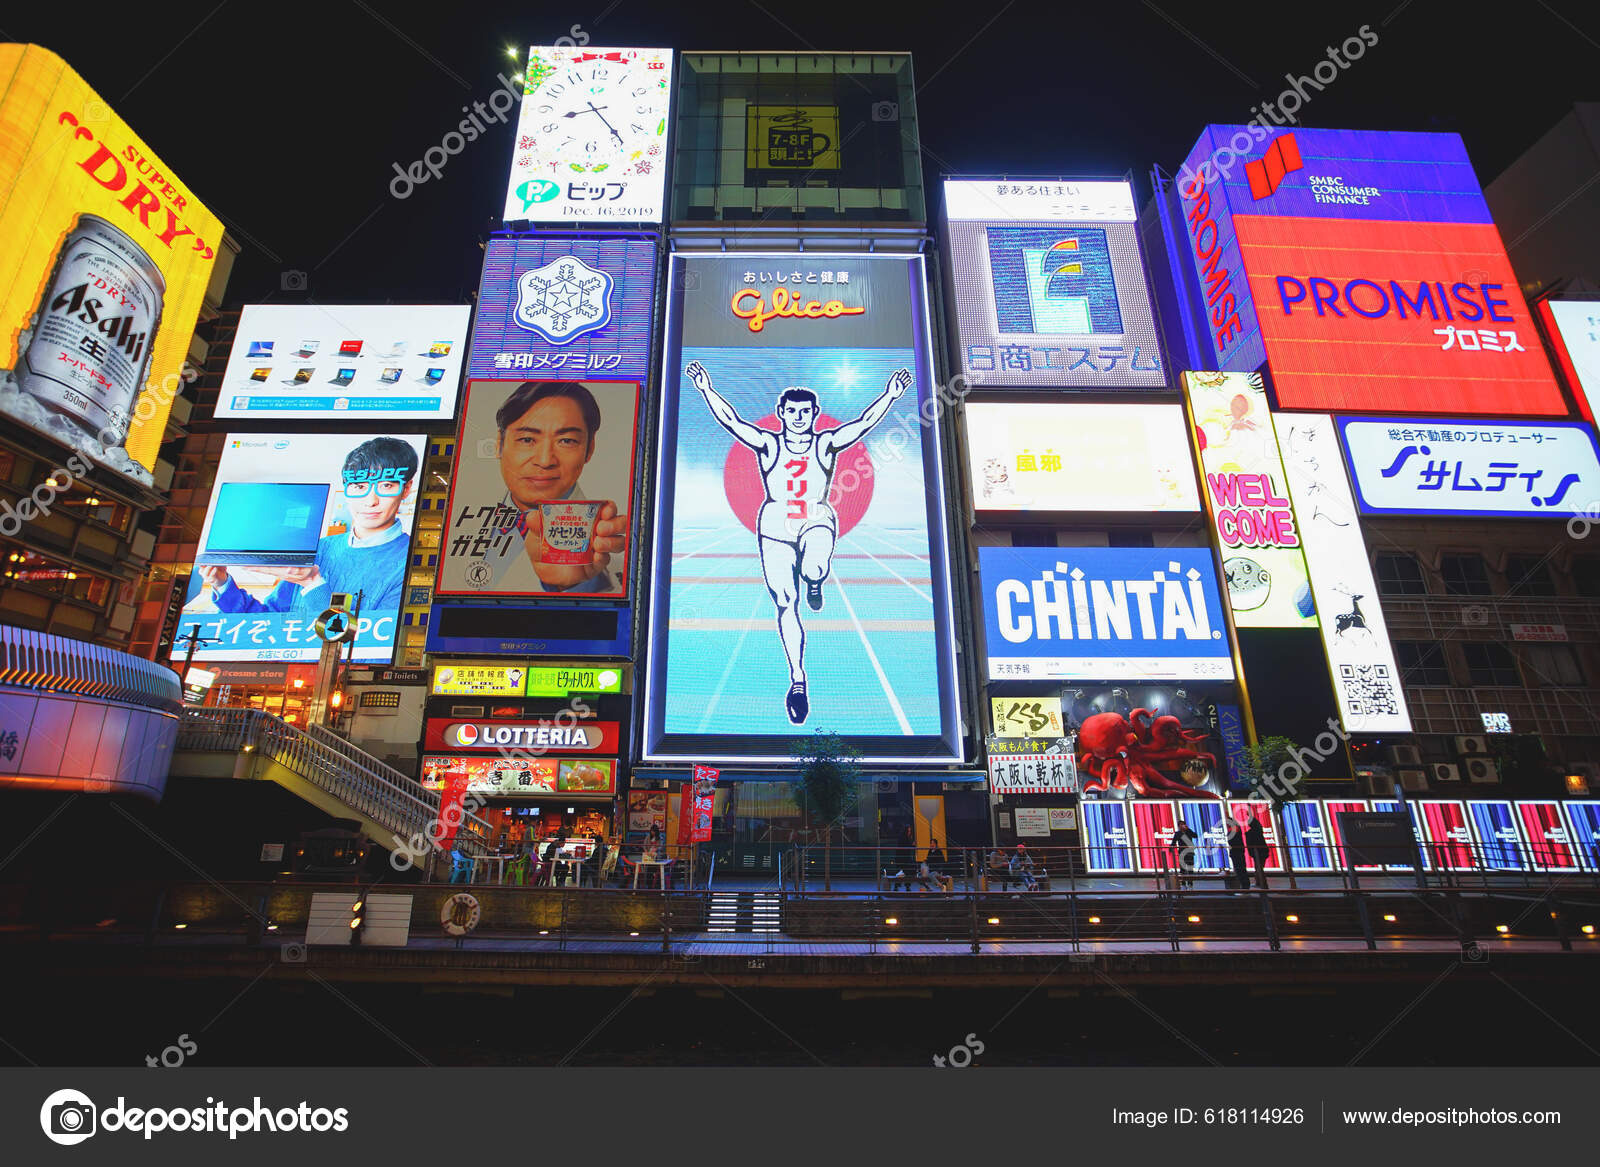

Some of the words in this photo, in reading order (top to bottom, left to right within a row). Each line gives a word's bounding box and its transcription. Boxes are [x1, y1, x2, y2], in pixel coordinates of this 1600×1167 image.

[630, 123, 645, 134] 4
[585, 141, 598, 152] 6
[121, 144, 190, 213] SUPER
[1309, 176, 1344, 186] SMBC
[567, 182, 628, 201] ピップ
[1311, 185, 1382, 197] CONSUMER
[1314, 194, 1371, 205] FINANCE
[562, 206, 593, 216] Dec.
[618, 206, 653, 216] 2019
[1181, 172, 1243, 352] PROMISE
[743, 271, 850, 285] おいしさと健康
[1274, 275, 1517, 324] PROMISE
[51, 282, 147, 363] Asahi
[79, 336, 107, 364] 生
[1433, 325, 1526, 354] プロミス
[493, 352, 623, 371] 雪印メグミルク
[967, 344, 1162, 373] 日商エステム
[57, 352, 113, 391] スーパードライ
[62, 390, 89, 411] 350ml
[1387, 428, 1559, 444] 総合不動産のプロデューサー
[1016, 453, 1063, 473] 風邪
[1416, 460, 1543, 493] サムティ
[784, 456, 809, 520] グリコ
[1207, 472, 1289, 508] WEL
[455, 503, 518, 529] トクホ
[479, 528, 489, 536] の
[1217, 509, 1297, 546] COME
[450, 535, 514, 557] ガセリ
[996, 561, 1212, 643] CHINTAI
[260, 669, 284, 678] store
[394, 672, 418, 680] Toilets
[1006, 702, 1049, 731] くくる
[1480, 713, 1511, 728] BAR
[483, 726, 588, 745] LOTTERIA
[696, 767, 717, 781] たこ
[994, 761, 1064, 786] 大阪に乾杯
